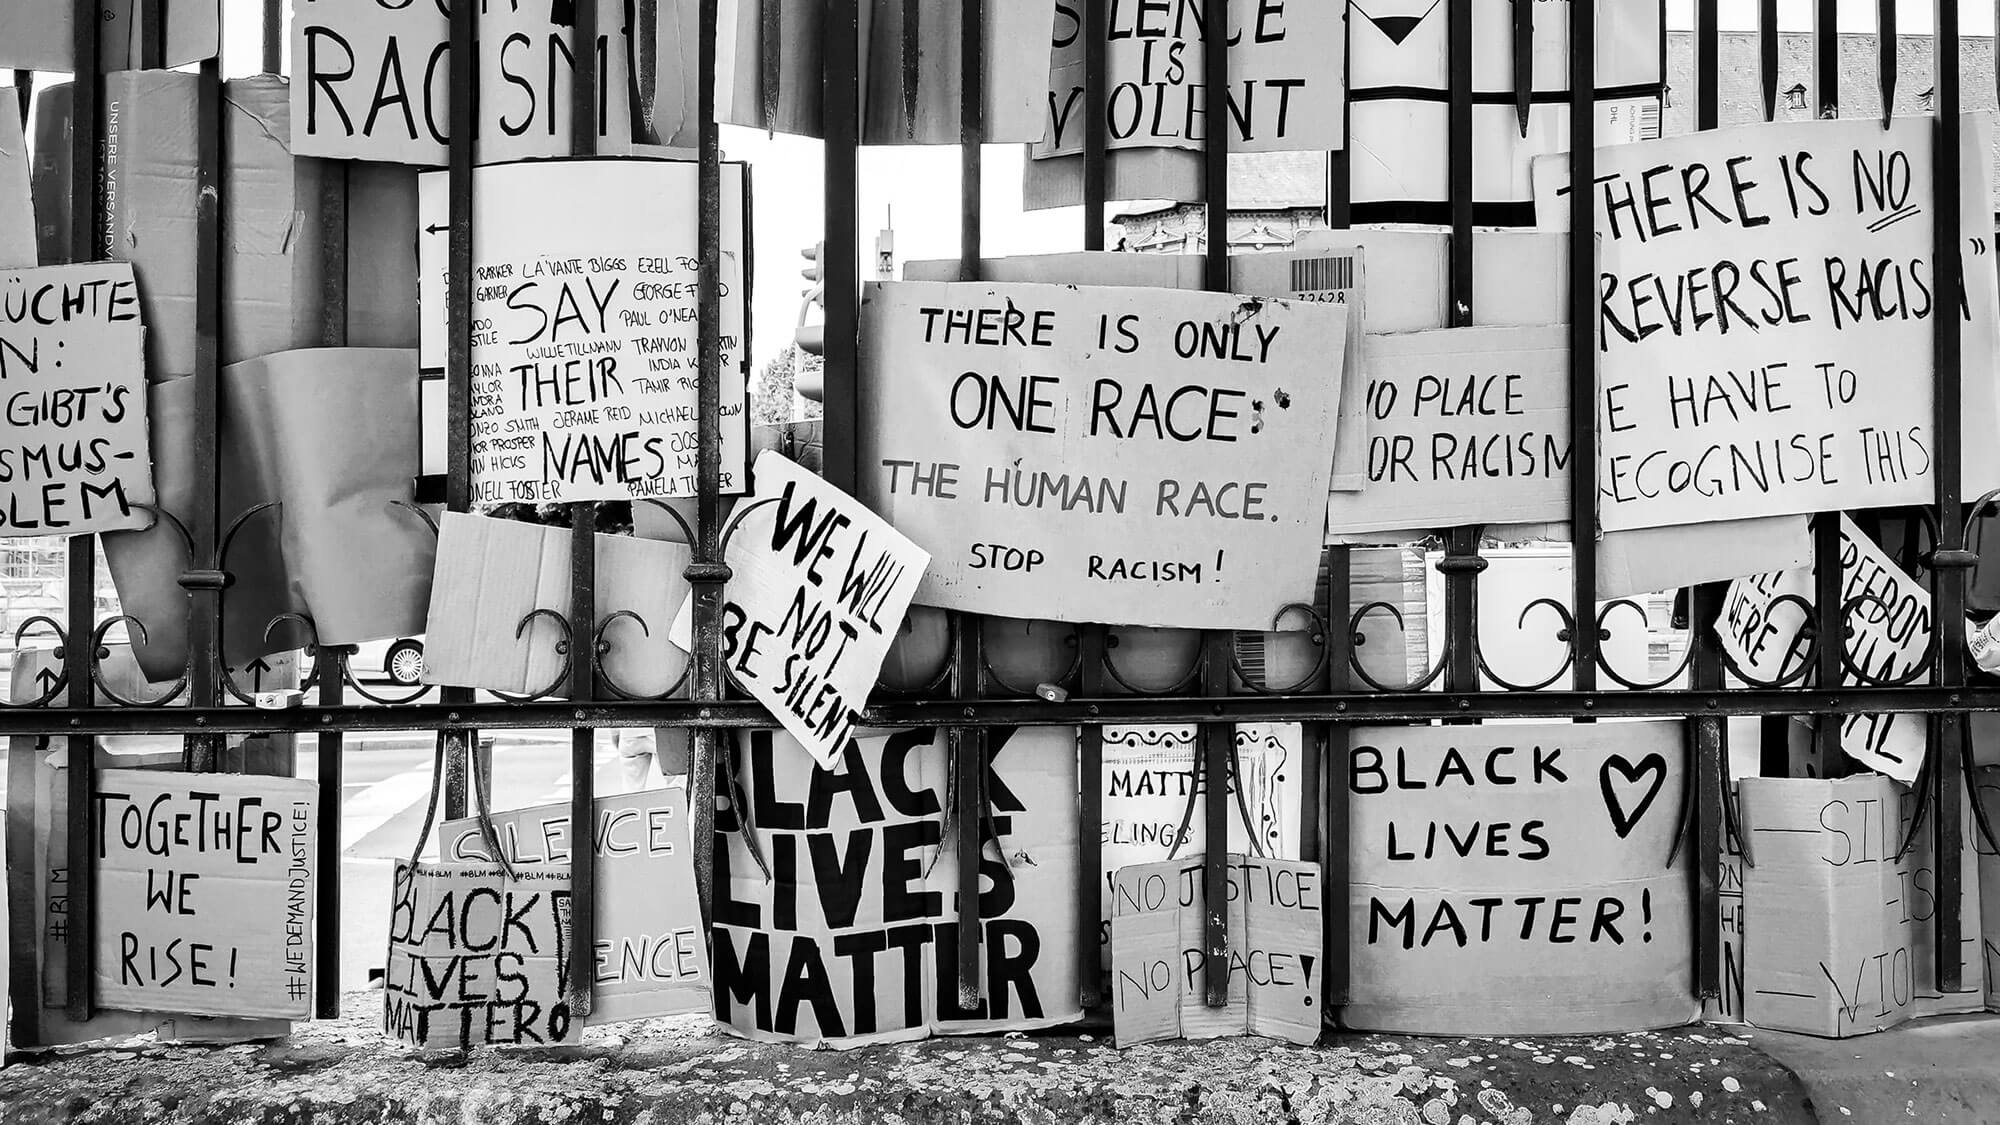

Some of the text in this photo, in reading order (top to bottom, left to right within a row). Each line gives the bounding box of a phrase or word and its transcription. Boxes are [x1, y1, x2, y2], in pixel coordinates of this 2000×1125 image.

[1141, 40, 1185, 85] IS
[107, 101, 119, 165] UNSERE
[1049, 79, 1306, 149] VOLENT
[1610, 106, 1618, 125] DHL
[1779, 151, 1829, 218] IS
[1853, 149, 1911, 215] NO
[588, 257, 627, 273] BIGGS
[0, 277, 138, 325] ÜCHTE
[507, 277, 620, 345] SAY
[619, 308, 698, 327] PAUL O'NEA
[1600, 259, 1811, 351] REVERSE
[919, 308, 1281, 363] THERE IS ONLY
[7, 383, 130, 427] GIBT'S
[509, 356, 624, 411] THEIR
[950, 372, 1059, 434] ONE
[1414, 374, 1524, 417] PLACE
[1606, 362, 1857, 433] E HAVE TO
[504, 417, 539, 432] SMITH
[603, 406, 632, 421] REID
[639, 406, 699, 426] MICHAEL
[542, 431, 665, 485] NAMES
[1368, 432, 1572, 482] OR RACISM
[1600, 426, 1929, 502] ECOGNISE THIS
[882, 459, 1279, 523] THE HUMAN RACE.
[771, 481, 905, 635] WE WILL
[968, 543, 1045, 573] STOP
[724, 602, 774, 678] BE
[776, 585, 859, 680] NOT
[773, 654, 859, 759] SILENT
[715, 727, 1027, 832] BLACK
[1349, 744, 1568, 795] BLACK
[95, 791, 282, 863] TOGETHER
[1387, 820, 1550, 861] LIVES
[147, 868, 200, 915] WE
[714, 817, 1015, 932] LIVES
[1118, 874, 1166, 917] NO
[1179, 863, 1320, 911] JSTICE
[390, 864, 540, 954] BLACK
[1367, 887, 1653, 950] MATTER!
[121, 931, 238, 988] RISE!
[387, 952, 530, 1003] LIVES
[712, 919, 1044, 1038] MATTER
[1119, 948, 1315, 1012] NO PACE!
